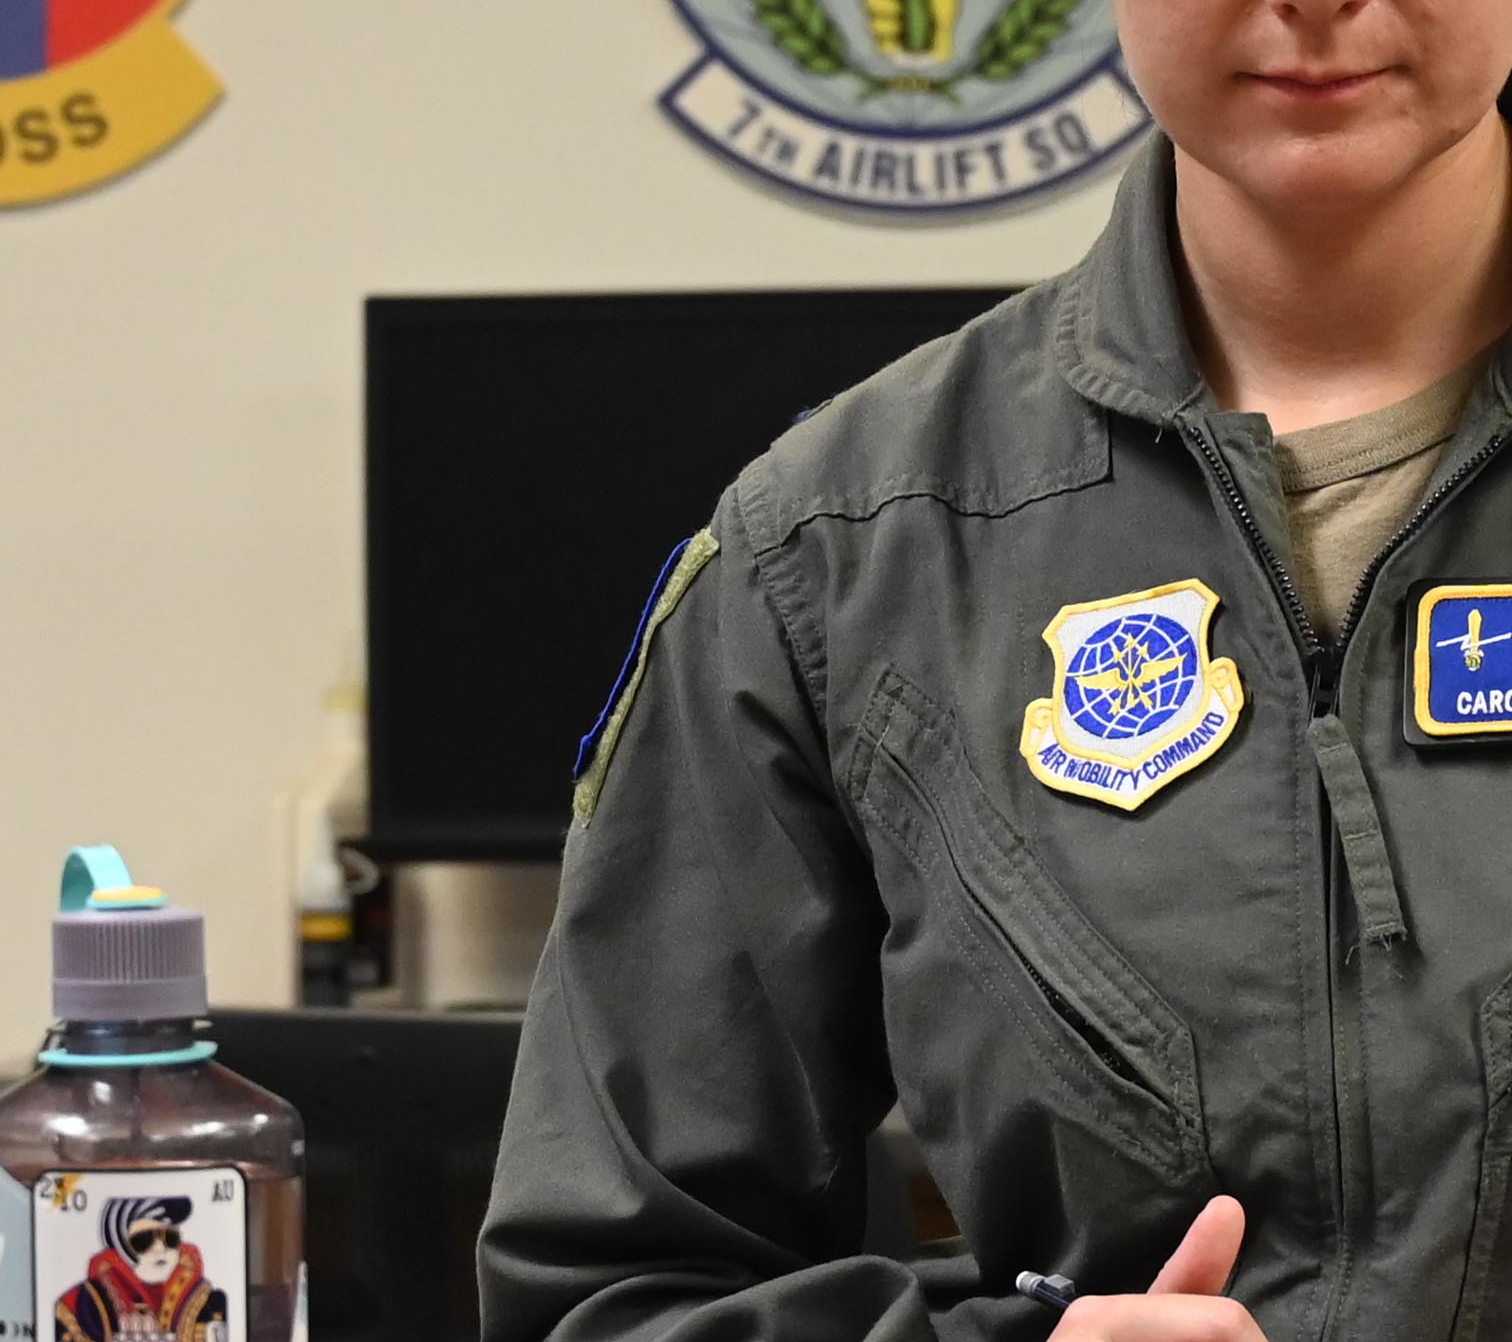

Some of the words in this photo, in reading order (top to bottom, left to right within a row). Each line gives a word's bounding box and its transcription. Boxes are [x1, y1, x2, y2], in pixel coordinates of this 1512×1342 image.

[721, 96, 799, 165] 7TH
[810, 135, 1013, 198] AIRLIFT
[1024, 111, 1096, 173] SQ
[1038, 743, 1065, 773] AIR
[1064, 758, 1142, 791] MOBILITY
[1142, 711, 1225, 780] COMMAND
